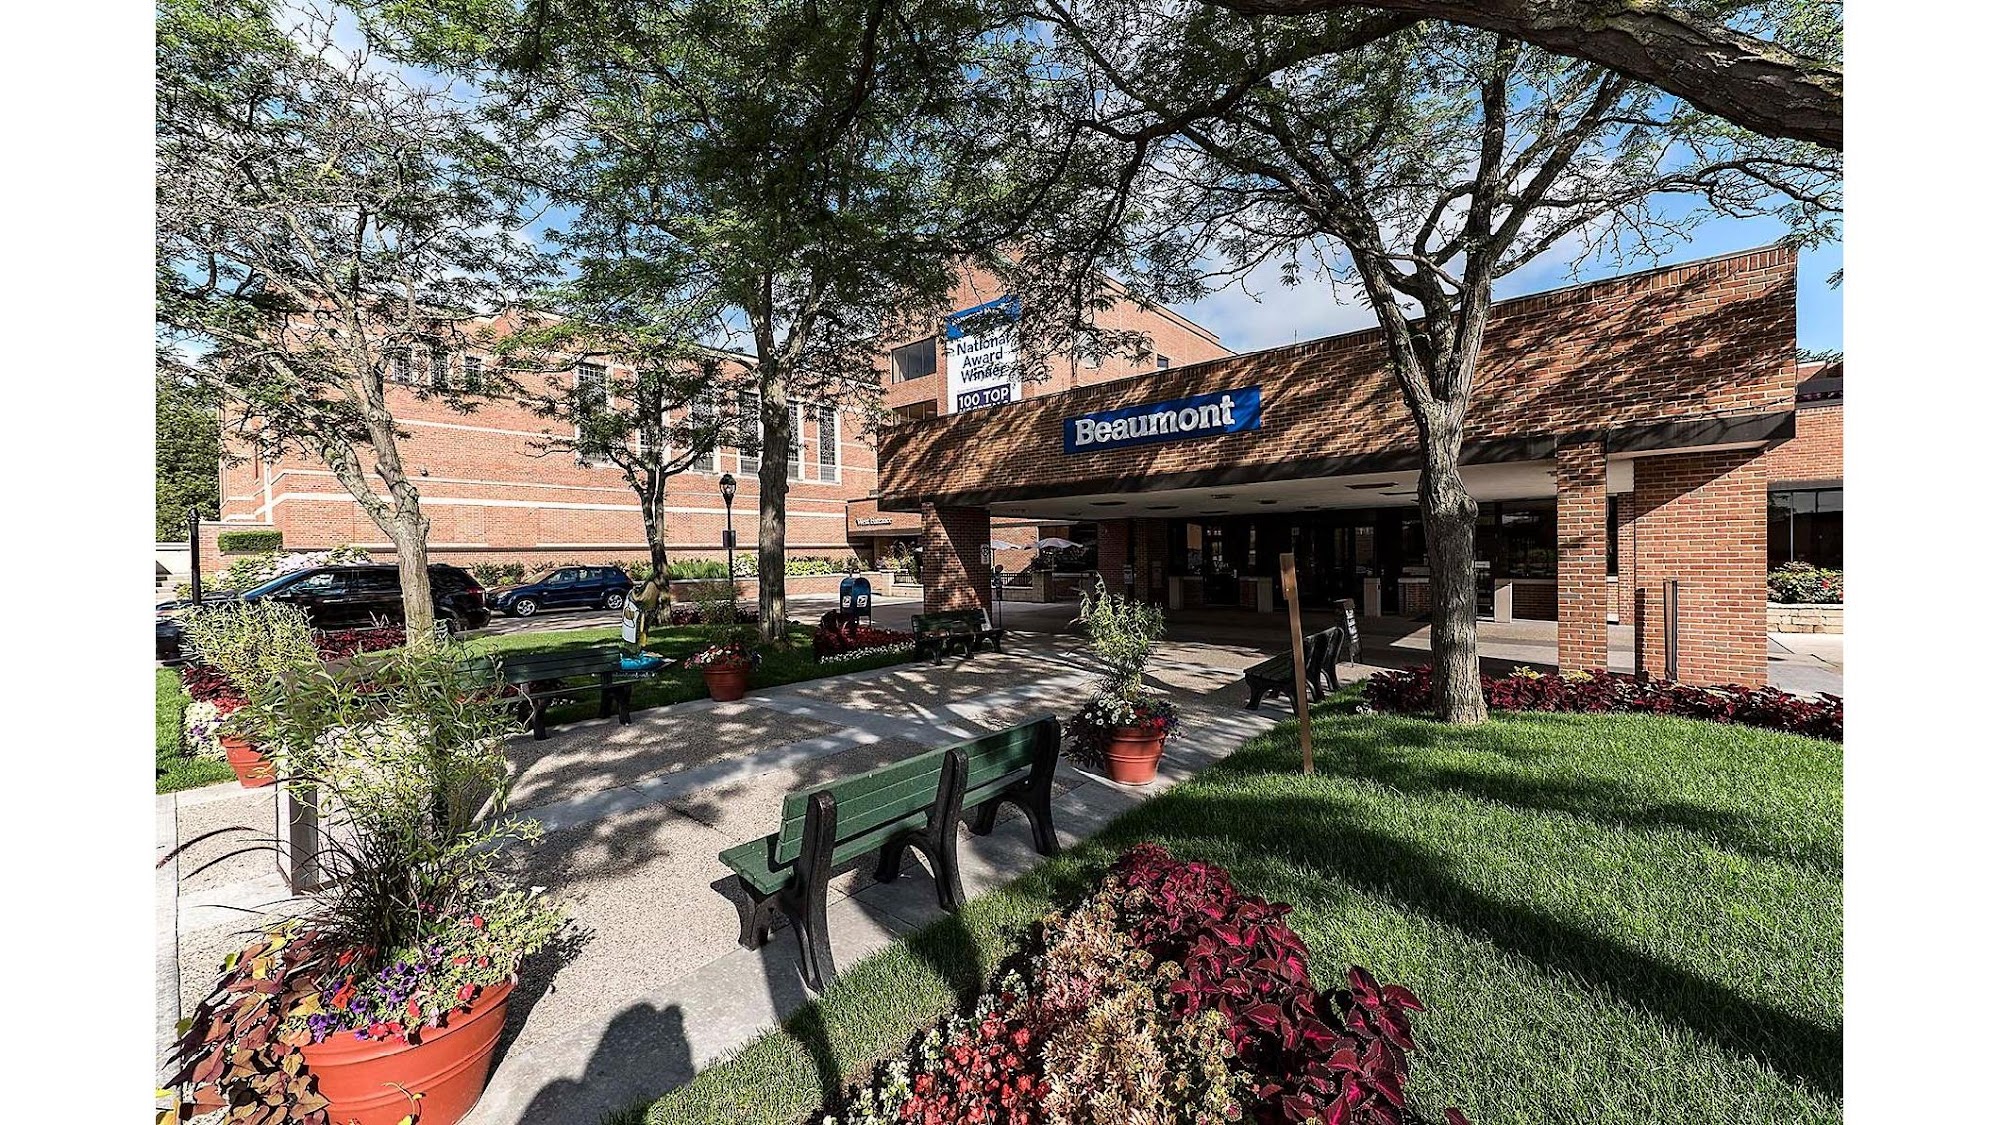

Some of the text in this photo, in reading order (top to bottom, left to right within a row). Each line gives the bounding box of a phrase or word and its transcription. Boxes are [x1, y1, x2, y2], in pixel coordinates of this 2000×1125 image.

[957, 334, 1010, 356] National
[962, 346, 1003, 369] Award
[958, 393, 980, 409] 100
[983, 387, 1009, 403] TOP
[1075, 394, 1235, 446] Beaumont
